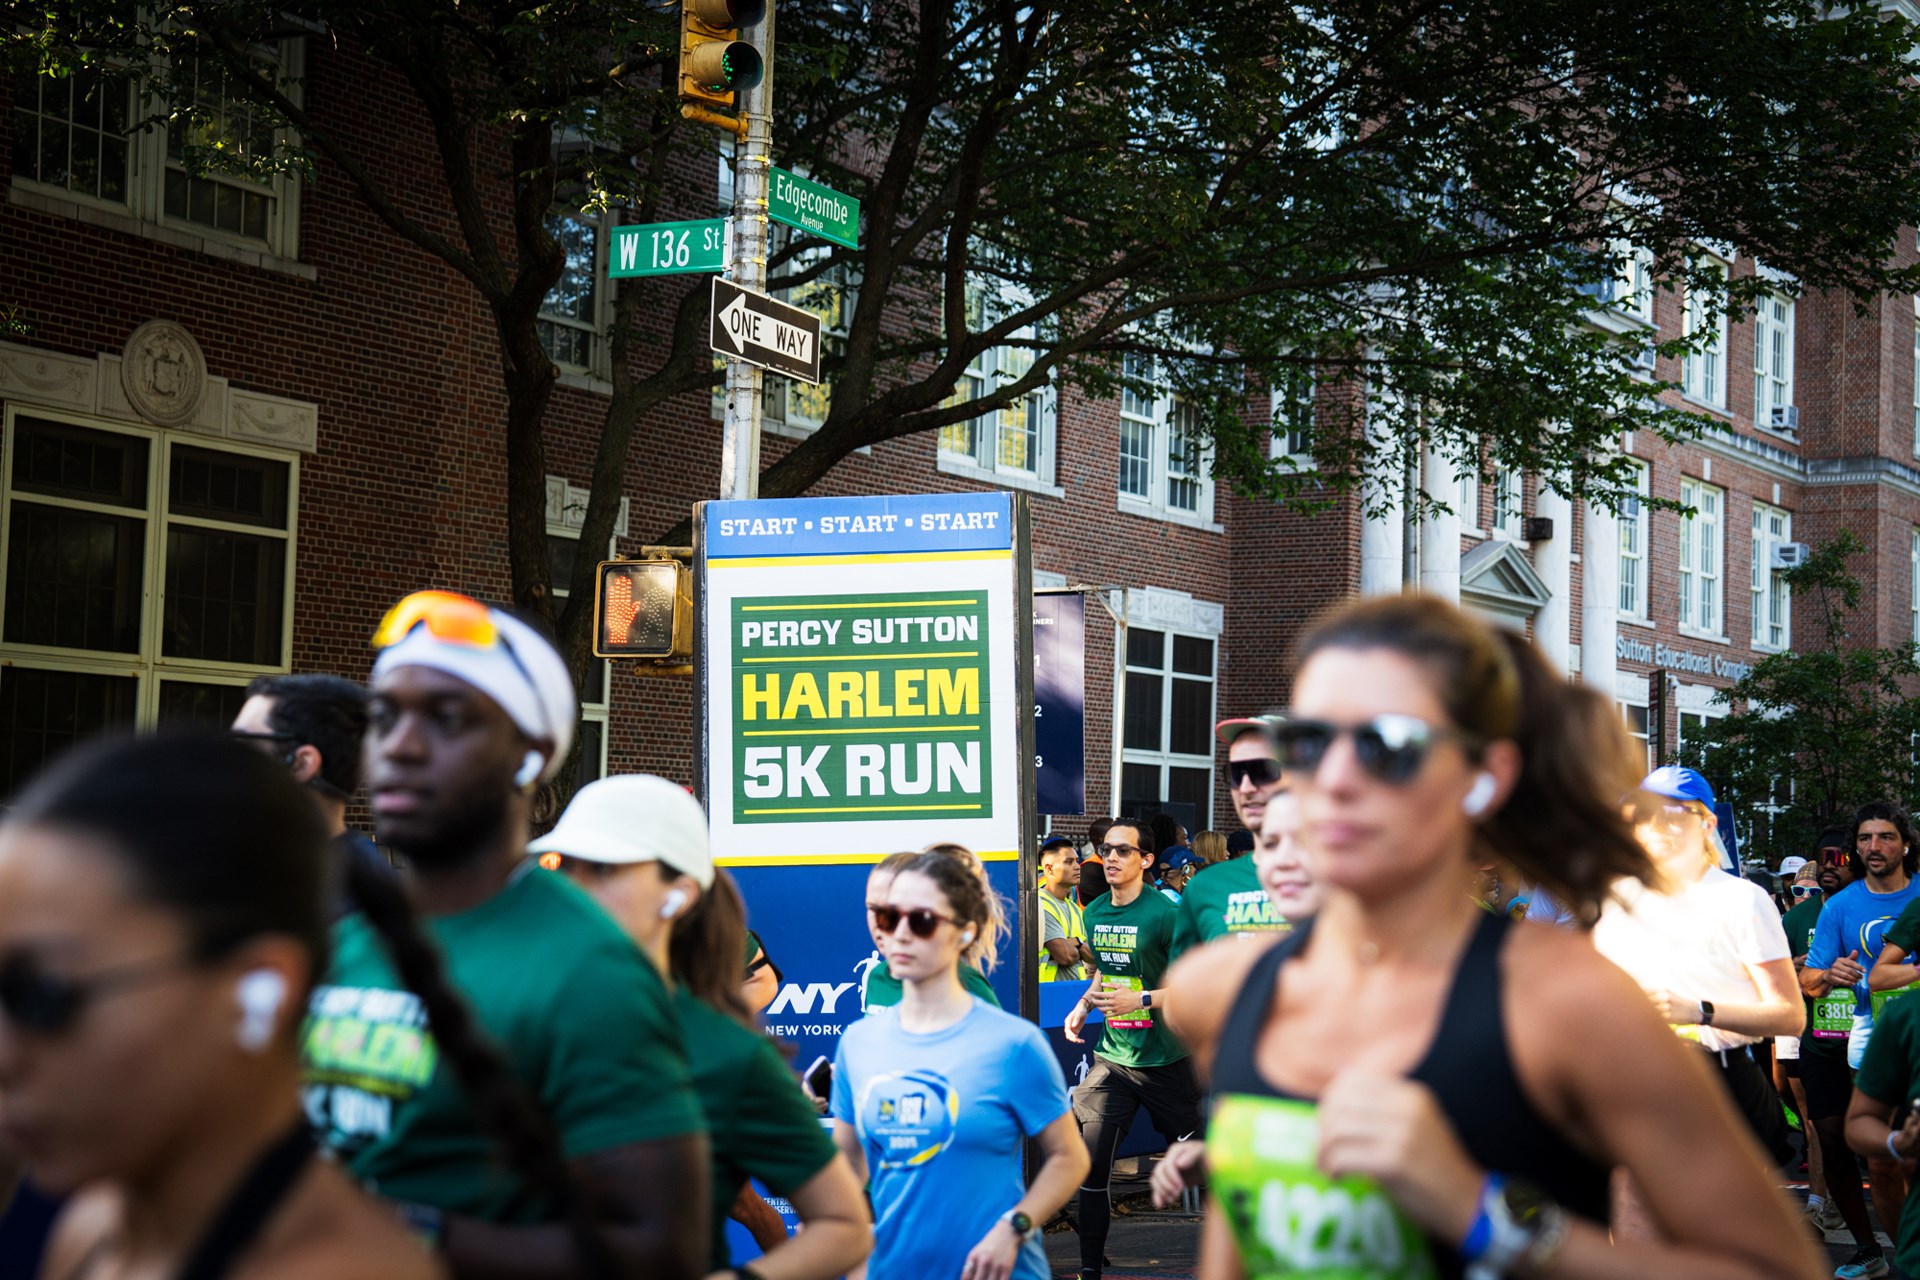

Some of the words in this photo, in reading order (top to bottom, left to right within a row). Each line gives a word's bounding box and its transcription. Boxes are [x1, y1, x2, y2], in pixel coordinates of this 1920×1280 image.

[776, 173, 848, 226] Edgecombe
[800, 213, 824, 232] Avenue
[619, 233, 639, 270] W
[651, 230, 691, 269] 136
[703, 227, 720, 251] St
[730, 307, 761, 342] ONE
[775, 323, 808, 358] WAY
[720, 517, 798, 537] START
[820, 514, 898, 534] START
[920, 511, 999, 531] START
[741, 619, 842, 647] PERCY
[851, 615, 978, 645] SUTTON
[1034, 654, 1041, 667] 1
[1616, 635, 1651, 663] Sutton
[1655, 642, 1712, 675] Educational
[741, 668, 980, 721] HARLEM
[1034, 705, 1042, 717] 2
[743, 744, 831, 799] 5K
[845, 741, 982, 797] RUN
[1035, 756, 1043, 767] 3
[1093, 932, 1137, 948] HARLEM
[1112, 925, 1138, 934] SUTTON
[1100, 952, 1113, 962] 5K
[1112, 952, 1131, 963] RUN
[765, 1024, 800, 1036] NEW
[802, 1024, 842, 1036] YORK
